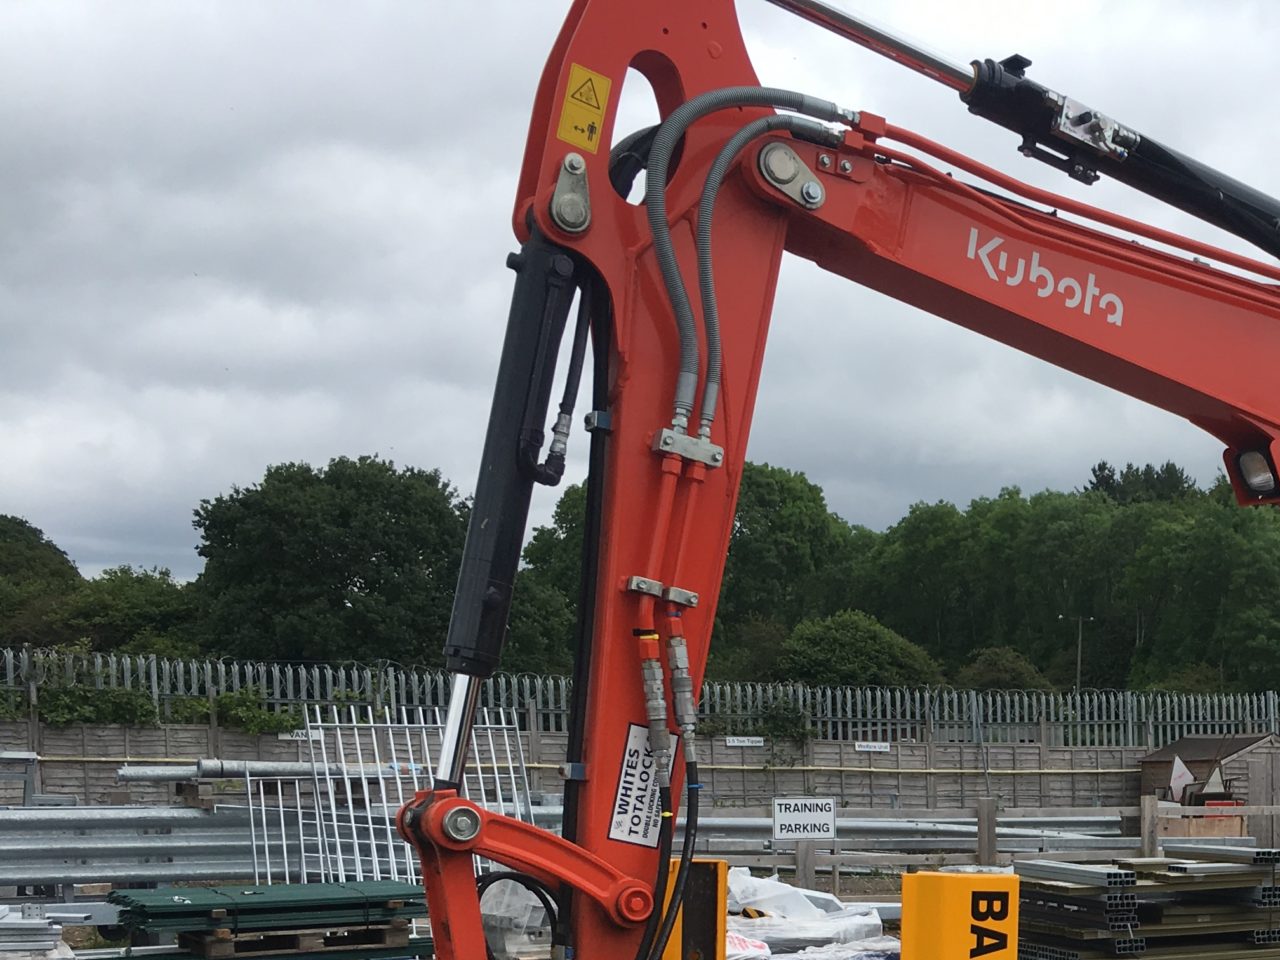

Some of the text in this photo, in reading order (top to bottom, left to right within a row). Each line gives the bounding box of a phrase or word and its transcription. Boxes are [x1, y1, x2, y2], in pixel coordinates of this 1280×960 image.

[967, 227, 1124, 327] Kubota
[617, 748, 639, 815] WHITES
[628, 747, 654, 837] TOTALOCK
[777, 803, 832, 813] TRAINING
[642, 815, 651, 838] DOUBLE
[647, 788, 657, 813] LOCKING
[780, 823, 830, 833] PARKING
